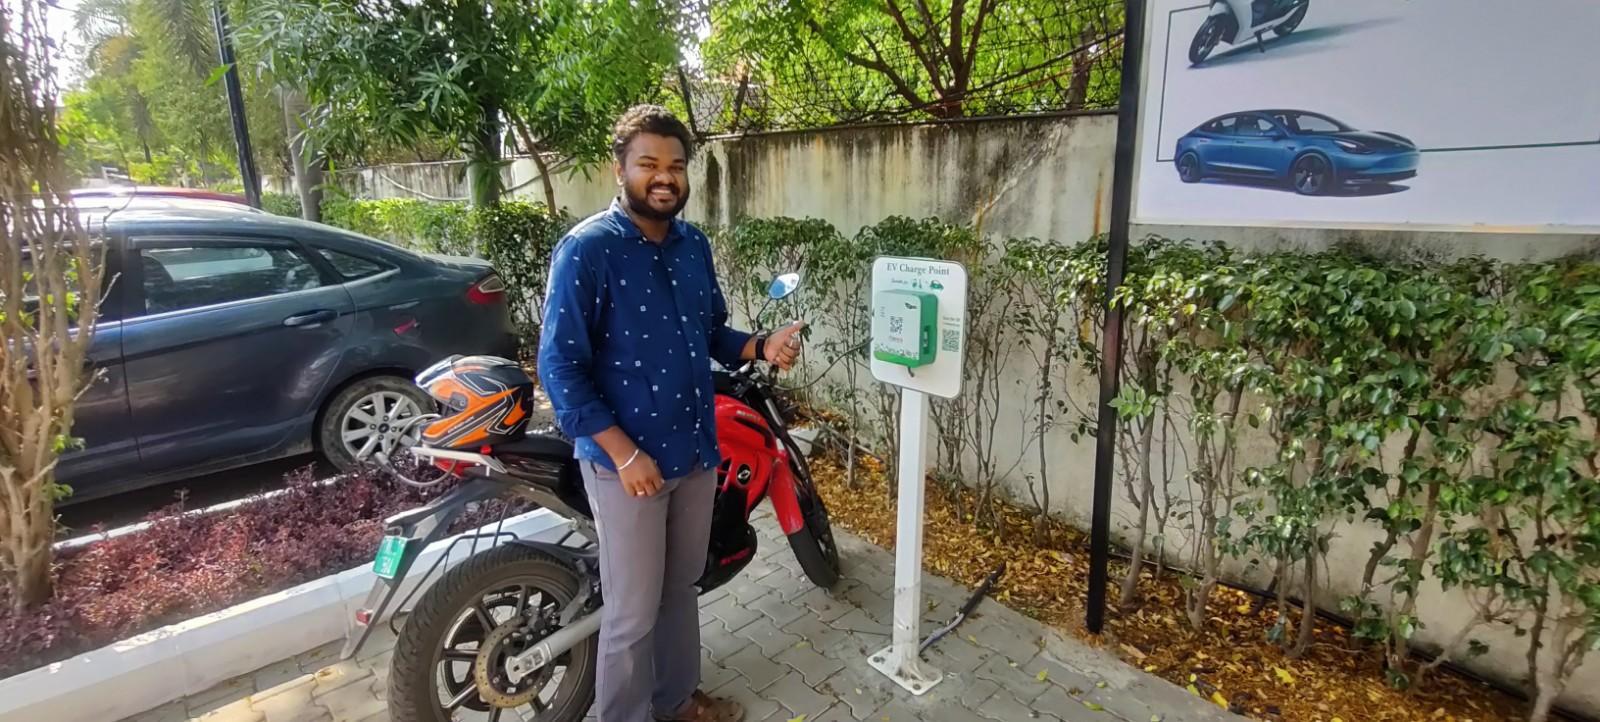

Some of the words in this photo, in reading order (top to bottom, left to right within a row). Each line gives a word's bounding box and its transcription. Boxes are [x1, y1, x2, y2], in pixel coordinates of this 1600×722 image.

[886, 262, 898, 271] EV
[899, 263, 926, 276] Charge
[928, 265, 950, 276] Point
